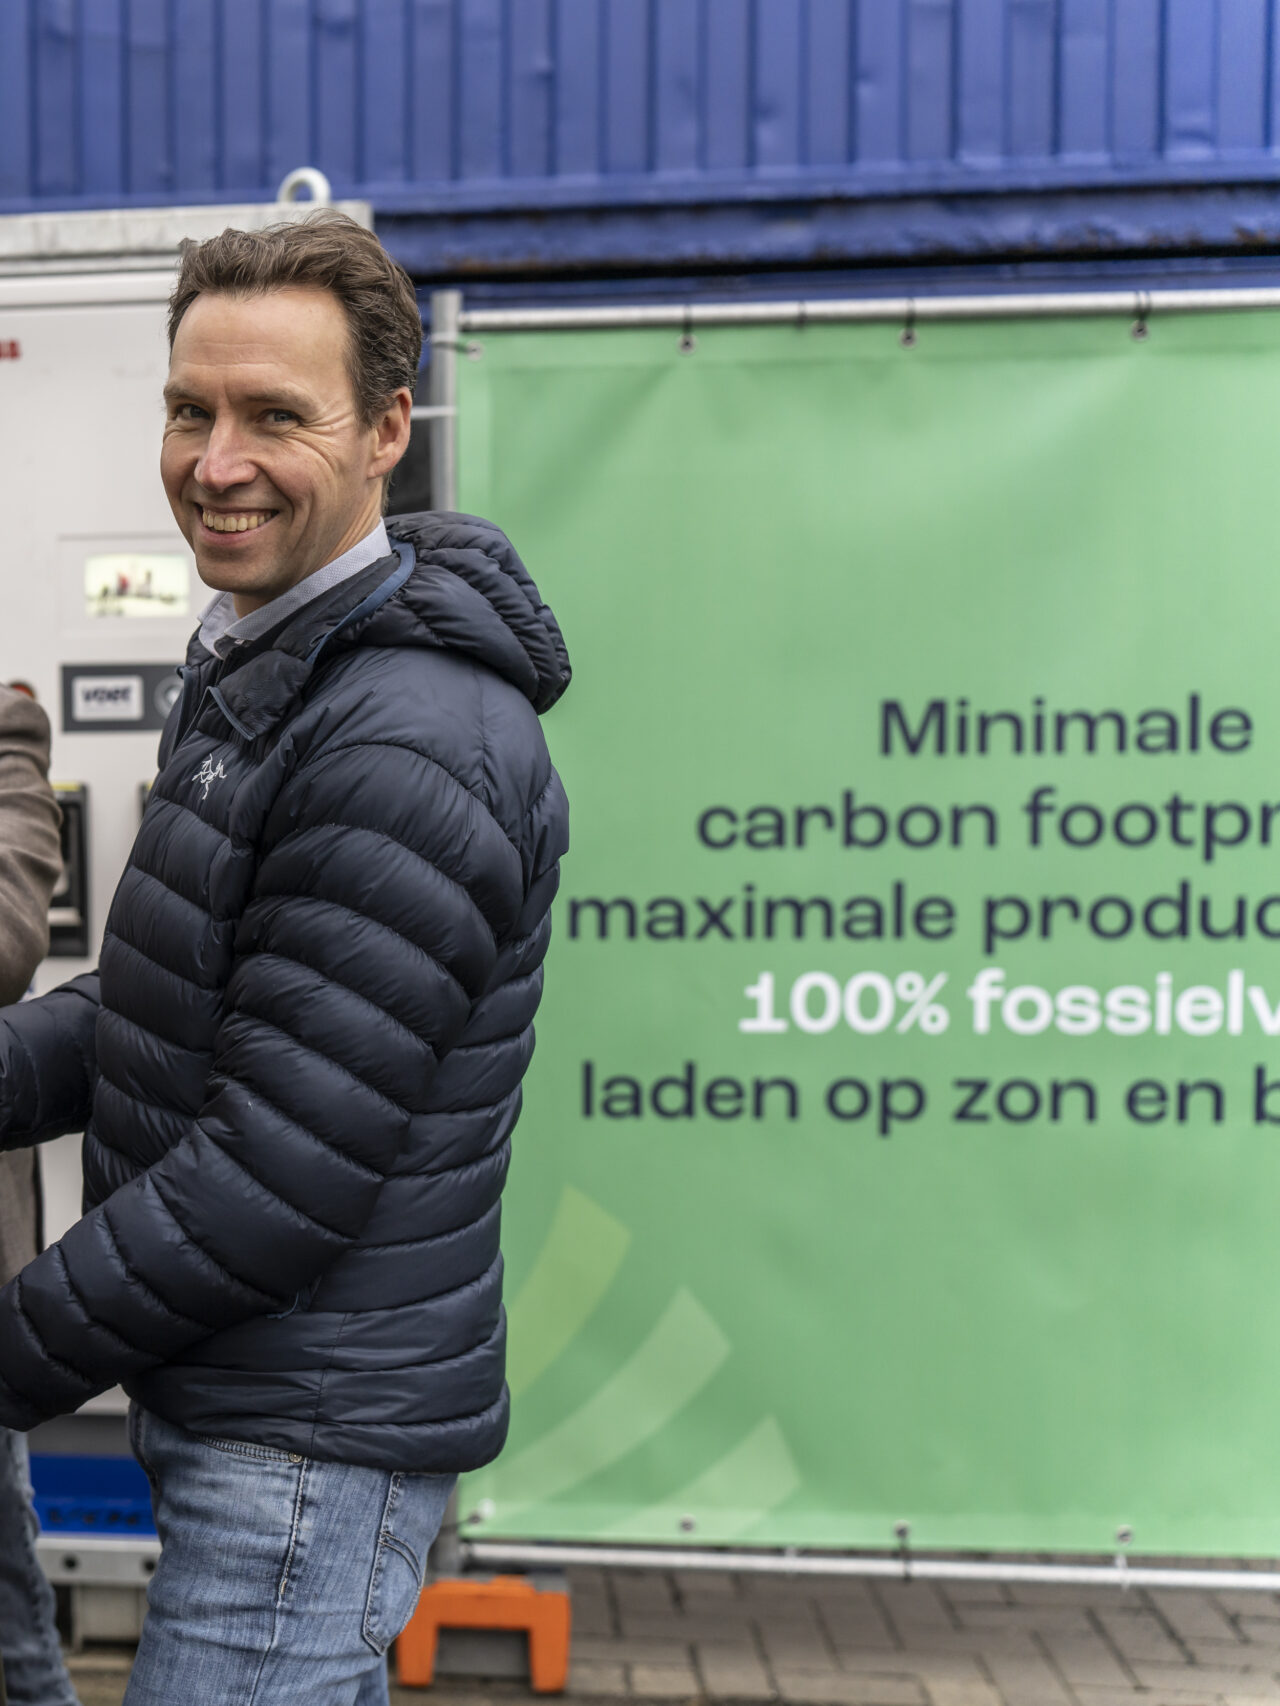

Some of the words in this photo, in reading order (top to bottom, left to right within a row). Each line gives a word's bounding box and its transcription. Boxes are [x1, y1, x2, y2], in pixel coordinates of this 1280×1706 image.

[881, 693, 1252, 757] Minimale
[697, 789, 997, 850] carbon
[567, 881, 956, 941] maximale
[739, 971, 950, 1035] 100%
[967, 967, 1280, 1036] fossielv
[581, 1060, 799, 1121] laden
[825, 1078, 927, 1137] op
[953, 1079, 1097, 1123] zon
[1125, 1080, 1224, 1124] en
